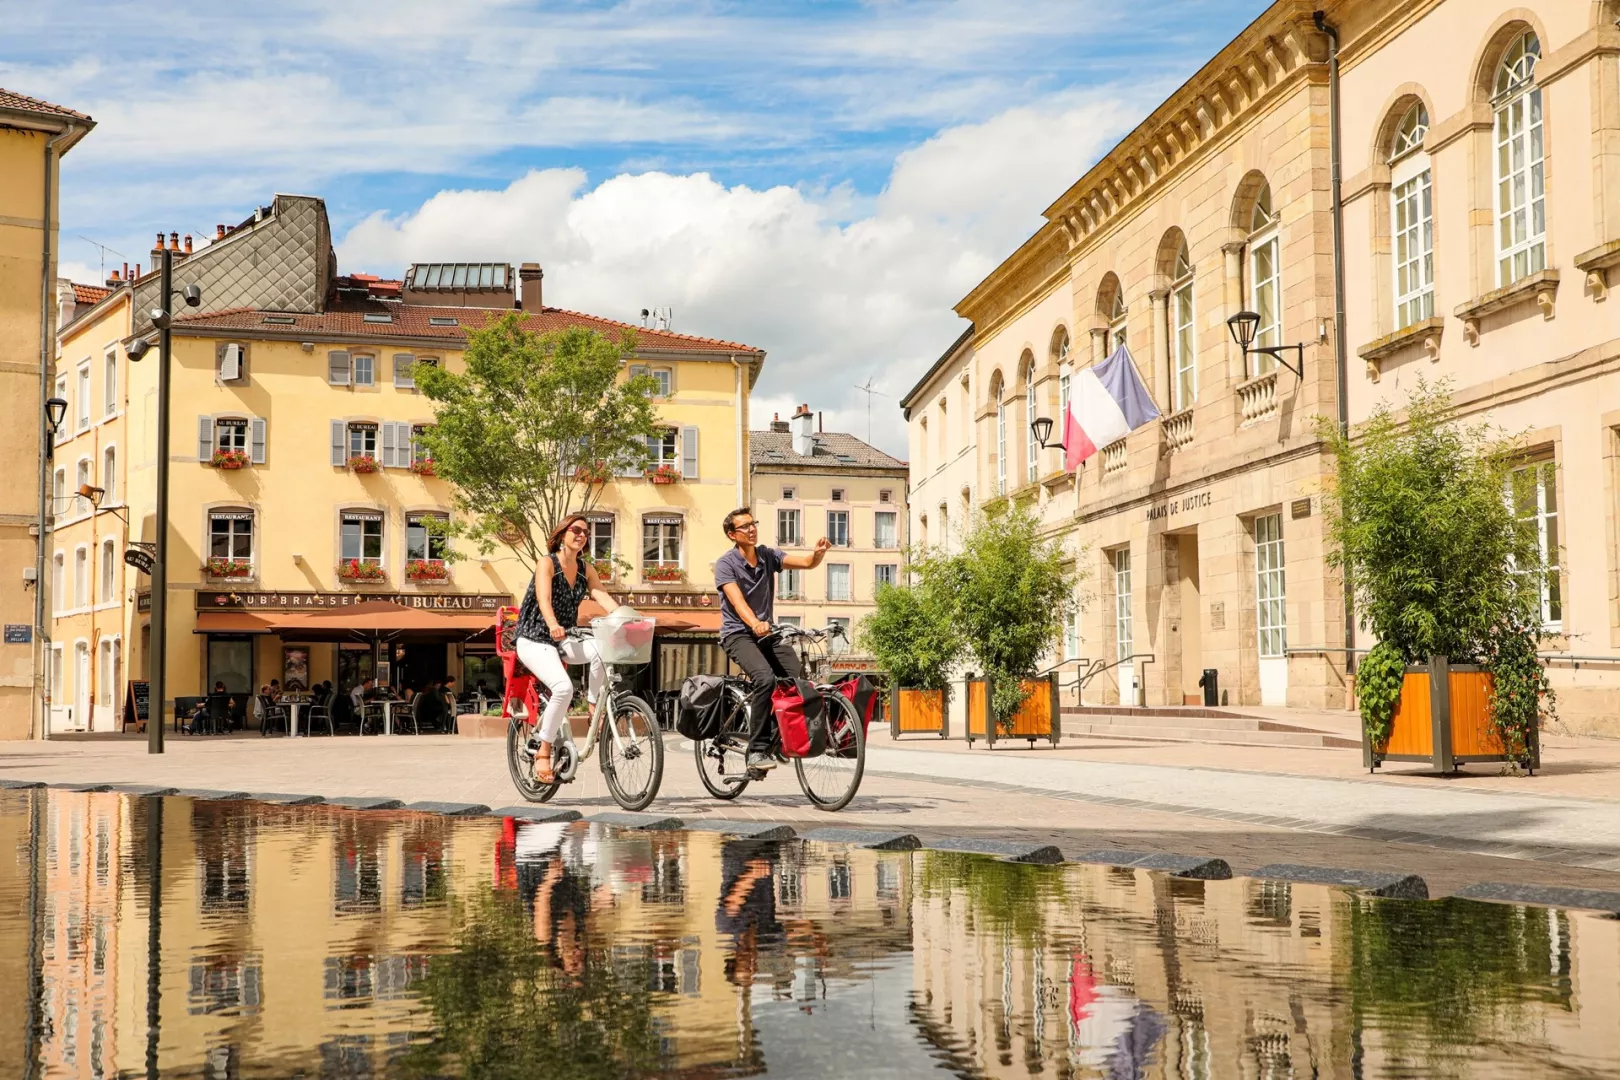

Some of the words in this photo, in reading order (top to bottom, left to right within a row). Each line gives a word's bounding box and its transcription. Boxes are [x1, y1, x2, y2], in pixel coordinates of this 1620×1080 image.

[1146, 505, 1168, 521] PALAIS
[1170, 502, 1178, 516] DE
[1182, 492, 1212, 512] JUSTICE
[234, 596, 267, 604] PUB
[412, 596, 472, 608] BUREAU
